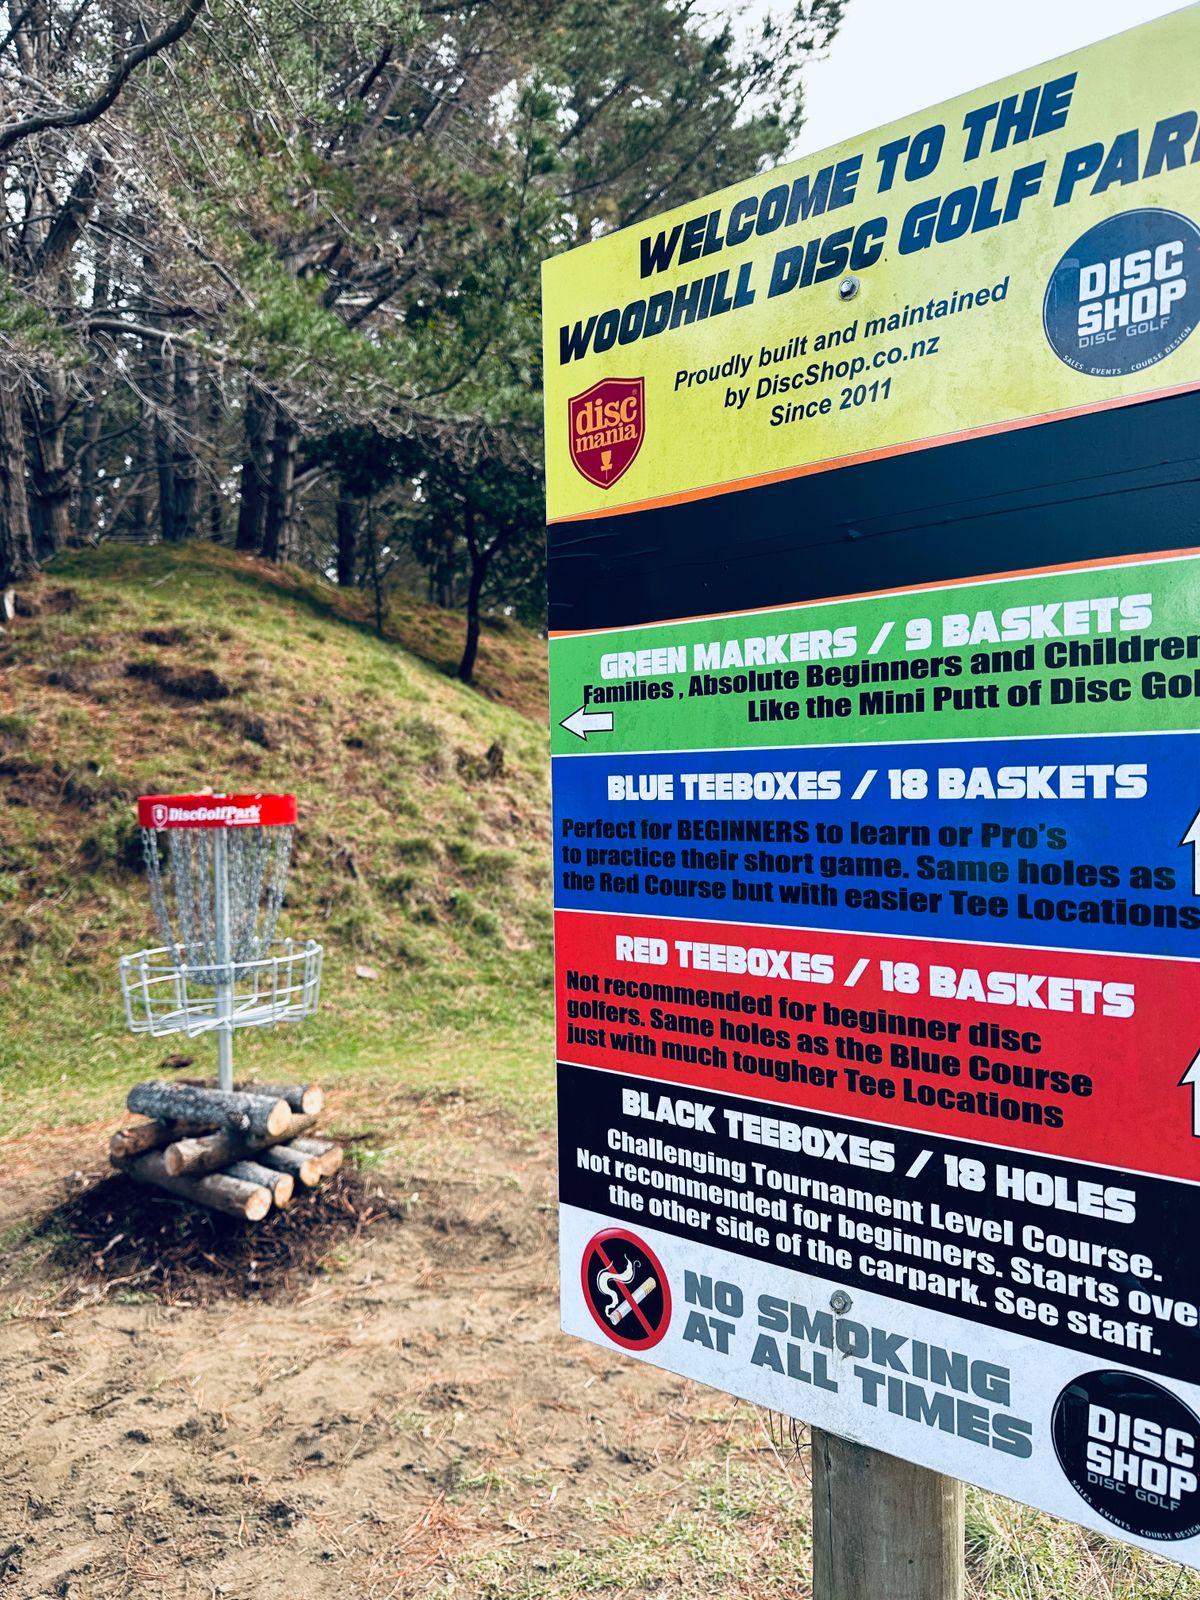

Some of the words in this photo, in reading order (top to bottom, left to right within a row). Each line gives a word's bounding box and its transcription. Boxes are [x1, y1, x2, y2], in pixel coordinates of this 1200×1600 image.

[640, 154, 863, 279] WELCOME
[877, 124, 946, 193] TO
[962, 71, 1078, 163] THE
[559, 261, 756, 365] WOODHILL
[767, 216, 887, 299] DISC
[898, 160, 1046, 255] GOLF
[1053, 110, 1200, 207] PAR
[1079, 240, 1184, 302] DISC
[674, 354, 753, 391] Proudly
[759, 337, 808, 368] built
[813, 320, 858, 350] and
[864, 276, 1010, 338] maintained
[1077, 278, 1187, 337] SHOP
[1079, 330, 1117, 349] DISC
[1126, 316, 1170, 337] GOLF
[724, 386, 750, 409] by
[756, 336, 941, 400] DiscShop.co.nz
[1063, 354, 1085, 370] SALES
[1090, 367, 1122, 375] EVENTS
[1131, 352, 1164, 371] COURSE
[1164, 325, 1192, 353] DESIGN
[575, 396, 638, 435] disc
[769, 395, 832, 426] Since
[839, 377, 892, 410] 2011
[575, 421, 638, 454] mania
[599, 645, 687, 680] GREEN
[693, 626, 858, 671] MARKERS
[867, 621, 896, 655] /
[905, 618, 932, 652] 9
[942, 592, 1153, 648] BASKETS
[688, 668, 800, 697] Absolute
[806, 654, 962, 688] Beginners
[970, 645, 1035, 675] and
[748, 700, 800, 722] Like
[806, 695, 852, 719] the
[859, 688, 925, 716] Mini
[933, 684, 1000, 712] Putt
[1007, 679, 1042, 707] of
[1050, 676, 1132, 705] Disc
[168, 804, 261, 821] DiscGolfPark
[607, 774, 673, 801] BLUE
[680, 770, 841, 801] TEEBOXES
[850, 770, 878, 800] /
[888, 768, 929, 800] 18
[938, 763, 1148, 800] BASKETS
[562, 818, 636, 839] Perfect
[641, 819, 672, 840] for
[677, 820, 809, 843] BEGINNERS
[816, 822, 843, 845] to
[850, 822, 930, 847] learn
[938, 824, 973, 848] or
[981, 822, 1068, 850] Pro's
[562, 846, 582, 865] to
[586, 847, 676, 868] practice
[681, 848, 738, 871] their
[744, 850, 814, 875] short
[820, 855, 909, 879] game.
[916, 855, 1009, 884] Same
[1018, 859, 1120, 888] holes
[1129, 865, 1176, 891] as
[563, 871, 595, 892] the
[599, 872, 640, 894] Red
[645, 874, 727, 900] Course
[732, 879, 773, 903] but
[779, 882, 838, 907] with
[844, 888, 943, 913] easier
[949, 890, 1009, 918] Tee
[1018, 893, 1200, 930] Locations
[615, 934, 668, 966] RED
[674, 940, 834, 984] TEEBOXES
[843, 958, 870, 987] /
[880, 960, 920, 994] 18
[929, 965, 1135, 1019] BASKETS
[566, 970, 599, 993] Not
[603, 977, 773, 1017] recommended
[778, 997, 817, 1023] for
[823, 1002, 961, 1043] beginner
[968, 1021, 1042, 1054] disc
[567, 998, 646, 1027] golfers.
[650, 1007, 714, 1037] Same
[720, 1018, 791, 1050] holes
[797, 1033, 829, 1056] as
[835, 1037, 883, 1065] the
[890, 1043, 961, 1078] Blue
[968, 1054, 1093, 1097] Course
[567, 1023, 606, 1048] just
[610, 1032, 657, 1057] with
[662, 1041, 727, 1069] much
[732, 1050, 838, 1089] tougher
[844, 1067, 896, 1099] Tee
[903, 1078, 1064, 1129] Locations
[622, 1088, 716, 1135] BLACK
[723, 1108, 895, 1173] TEEBOXES
[905, 1149, 934, 1179] /
[943, 1154, 986, 1192] 18
[996, 1164, 1136, 1224] HOLES
[607, 1128, 747, 1184] Challenging
[751, 1162, 924, 1225] Tournament
[930, 1203, 1014, 1246] Level
[1022, 1224, 1163, 1282] Course.
[576, 1148, 611, 1176] Not
[614, 1159, 788, 1223] recommended
[792, 1203, 839, 1234] for
[838, 1213, 1003, 1278] beginners.
[1010, 1256, 1120, 1307] Starts
[1128, 1289, 1200, 1327] ove
[608, 1184, 644, 1212] the
[649, 1197, 711, 1230] other
[716, 1216, 770, 1247] side
[775, 1232, 803, 1257] of
[806, 1239, 853, 1270] the
[859, 1254, 987, 1308] carpark.
[994, 1286, 1059, 1326] See
[1067, 1309, 1162, 1356] staff.
[684, 1269, 744, 1319] NO
[757, 1294, 1011, 1408] SMOKING
[682, 1310, 736, 1356] AT
[750, 1333, 838, 1394] ALL
[853, 1364, 1033, 1459] TIMES
[1087, 1403, 1195, 1469] DISC
[1086, 1441, 1198, 1501] SHOP
[1087, 1471, 1127, 1495] DISC
[1135, 1490, 1180, 1512] GOLF
[1071, 1479, 1092, 1503] SALES
[1099, 1507, 1131, 1531] EVENTS
[1140, 1528, 1172, 1540] COURSE
